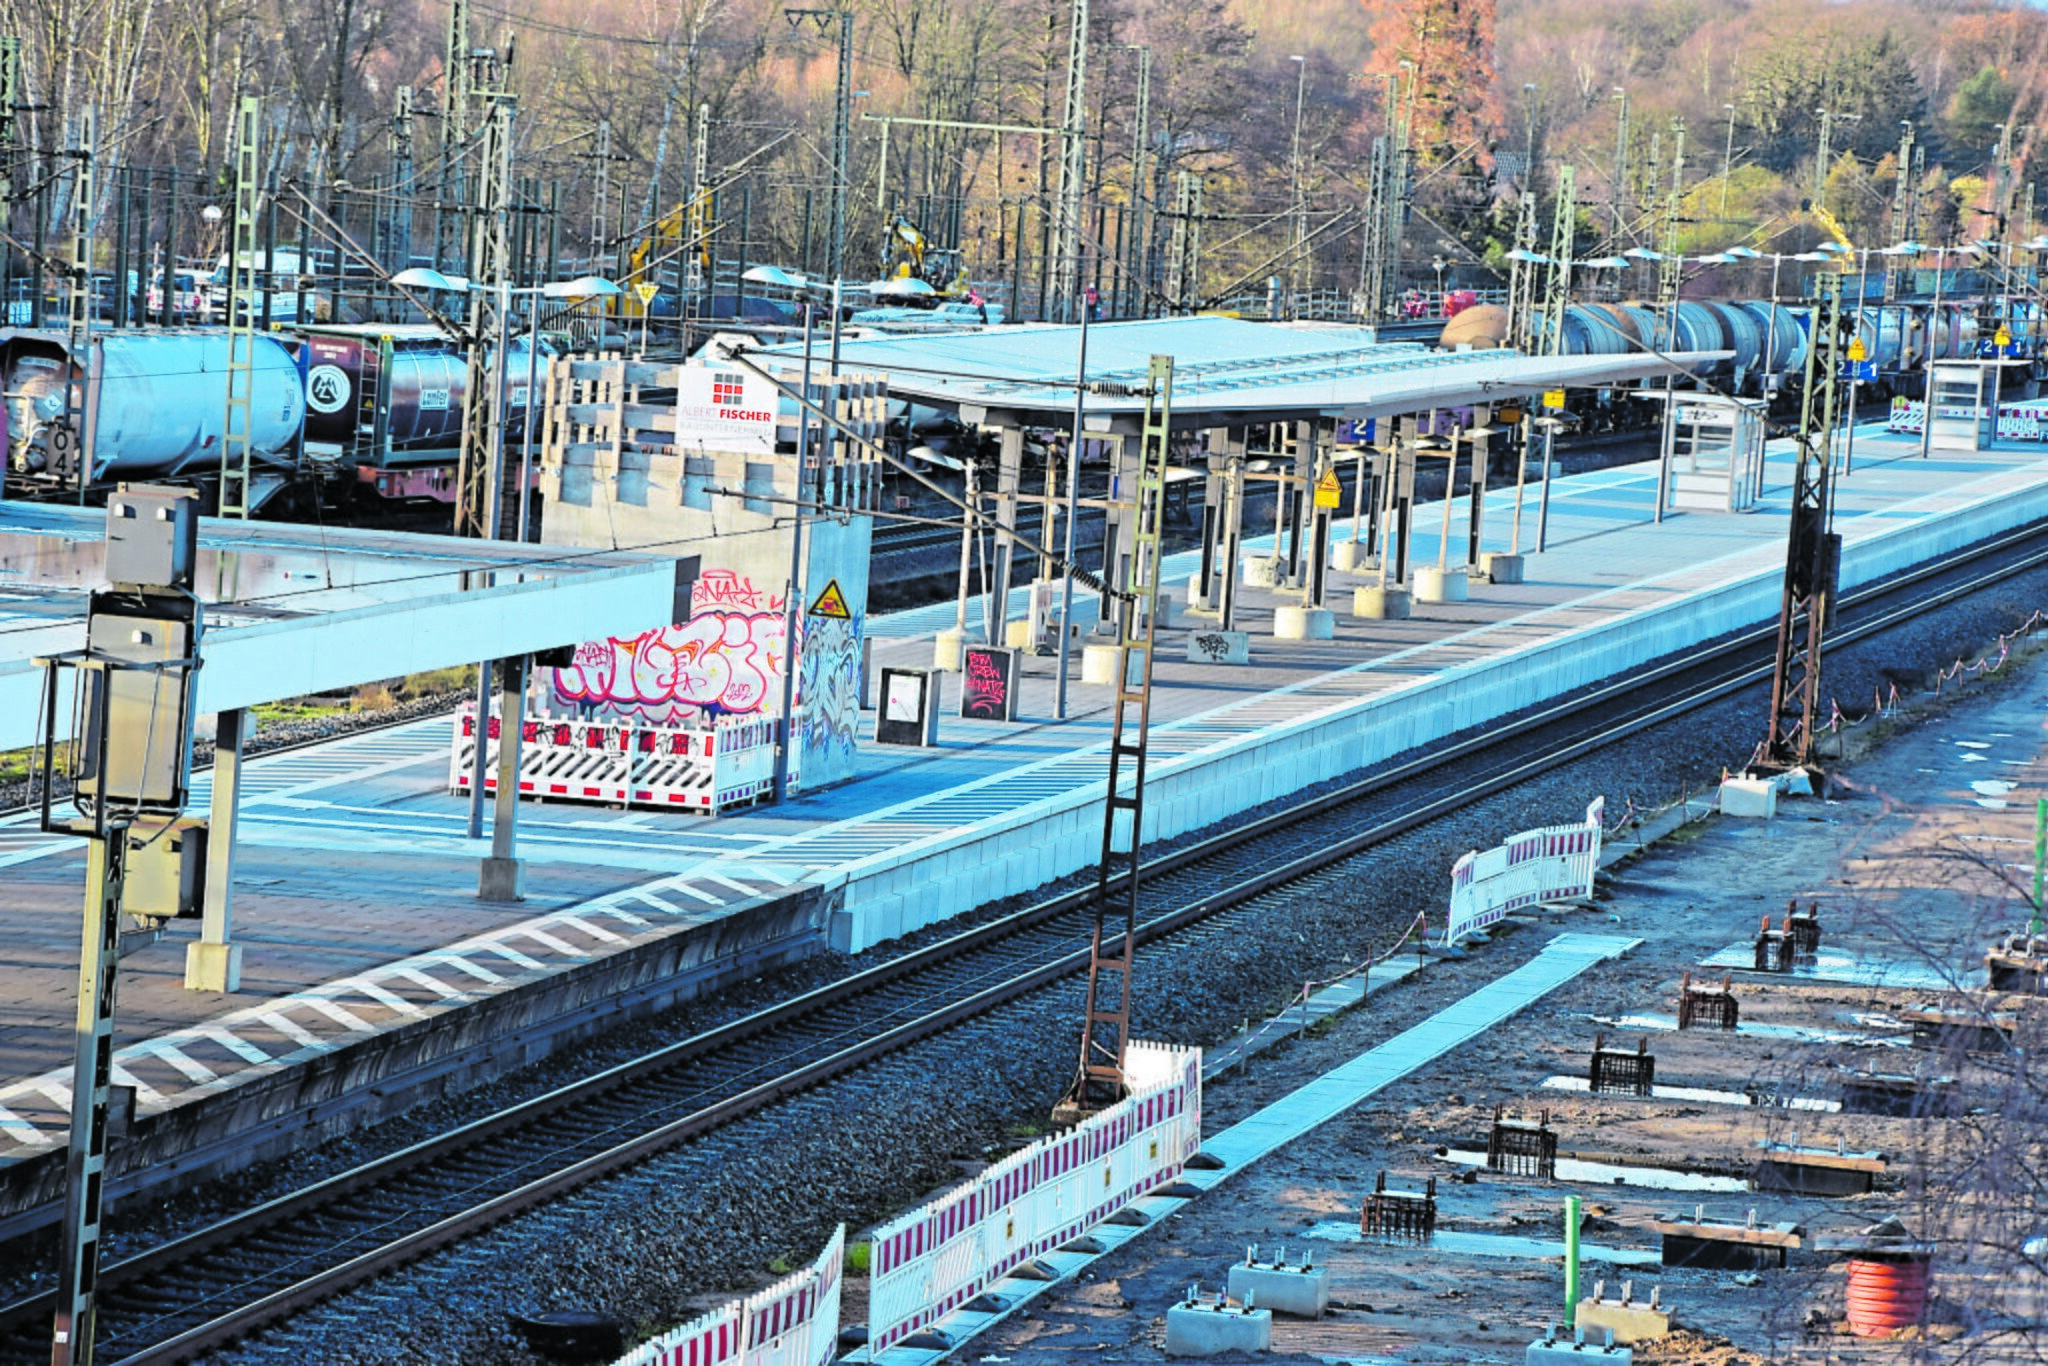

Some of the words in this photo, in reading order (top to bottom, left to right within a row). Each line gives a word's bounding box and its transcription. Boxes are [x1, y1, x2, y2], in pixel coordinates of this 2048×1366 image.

[1983, 340, 1993, 353] 2
[2014, 341, 2021, 354] 1
[1837, 361, 1846, 376] 2
[1869, 362, 1878, 377] 1
[681, 405, 717, 417] ALBERT
[719, 408, 772, 423] FISCHER
[1353, 418, 1367, 435] 2
